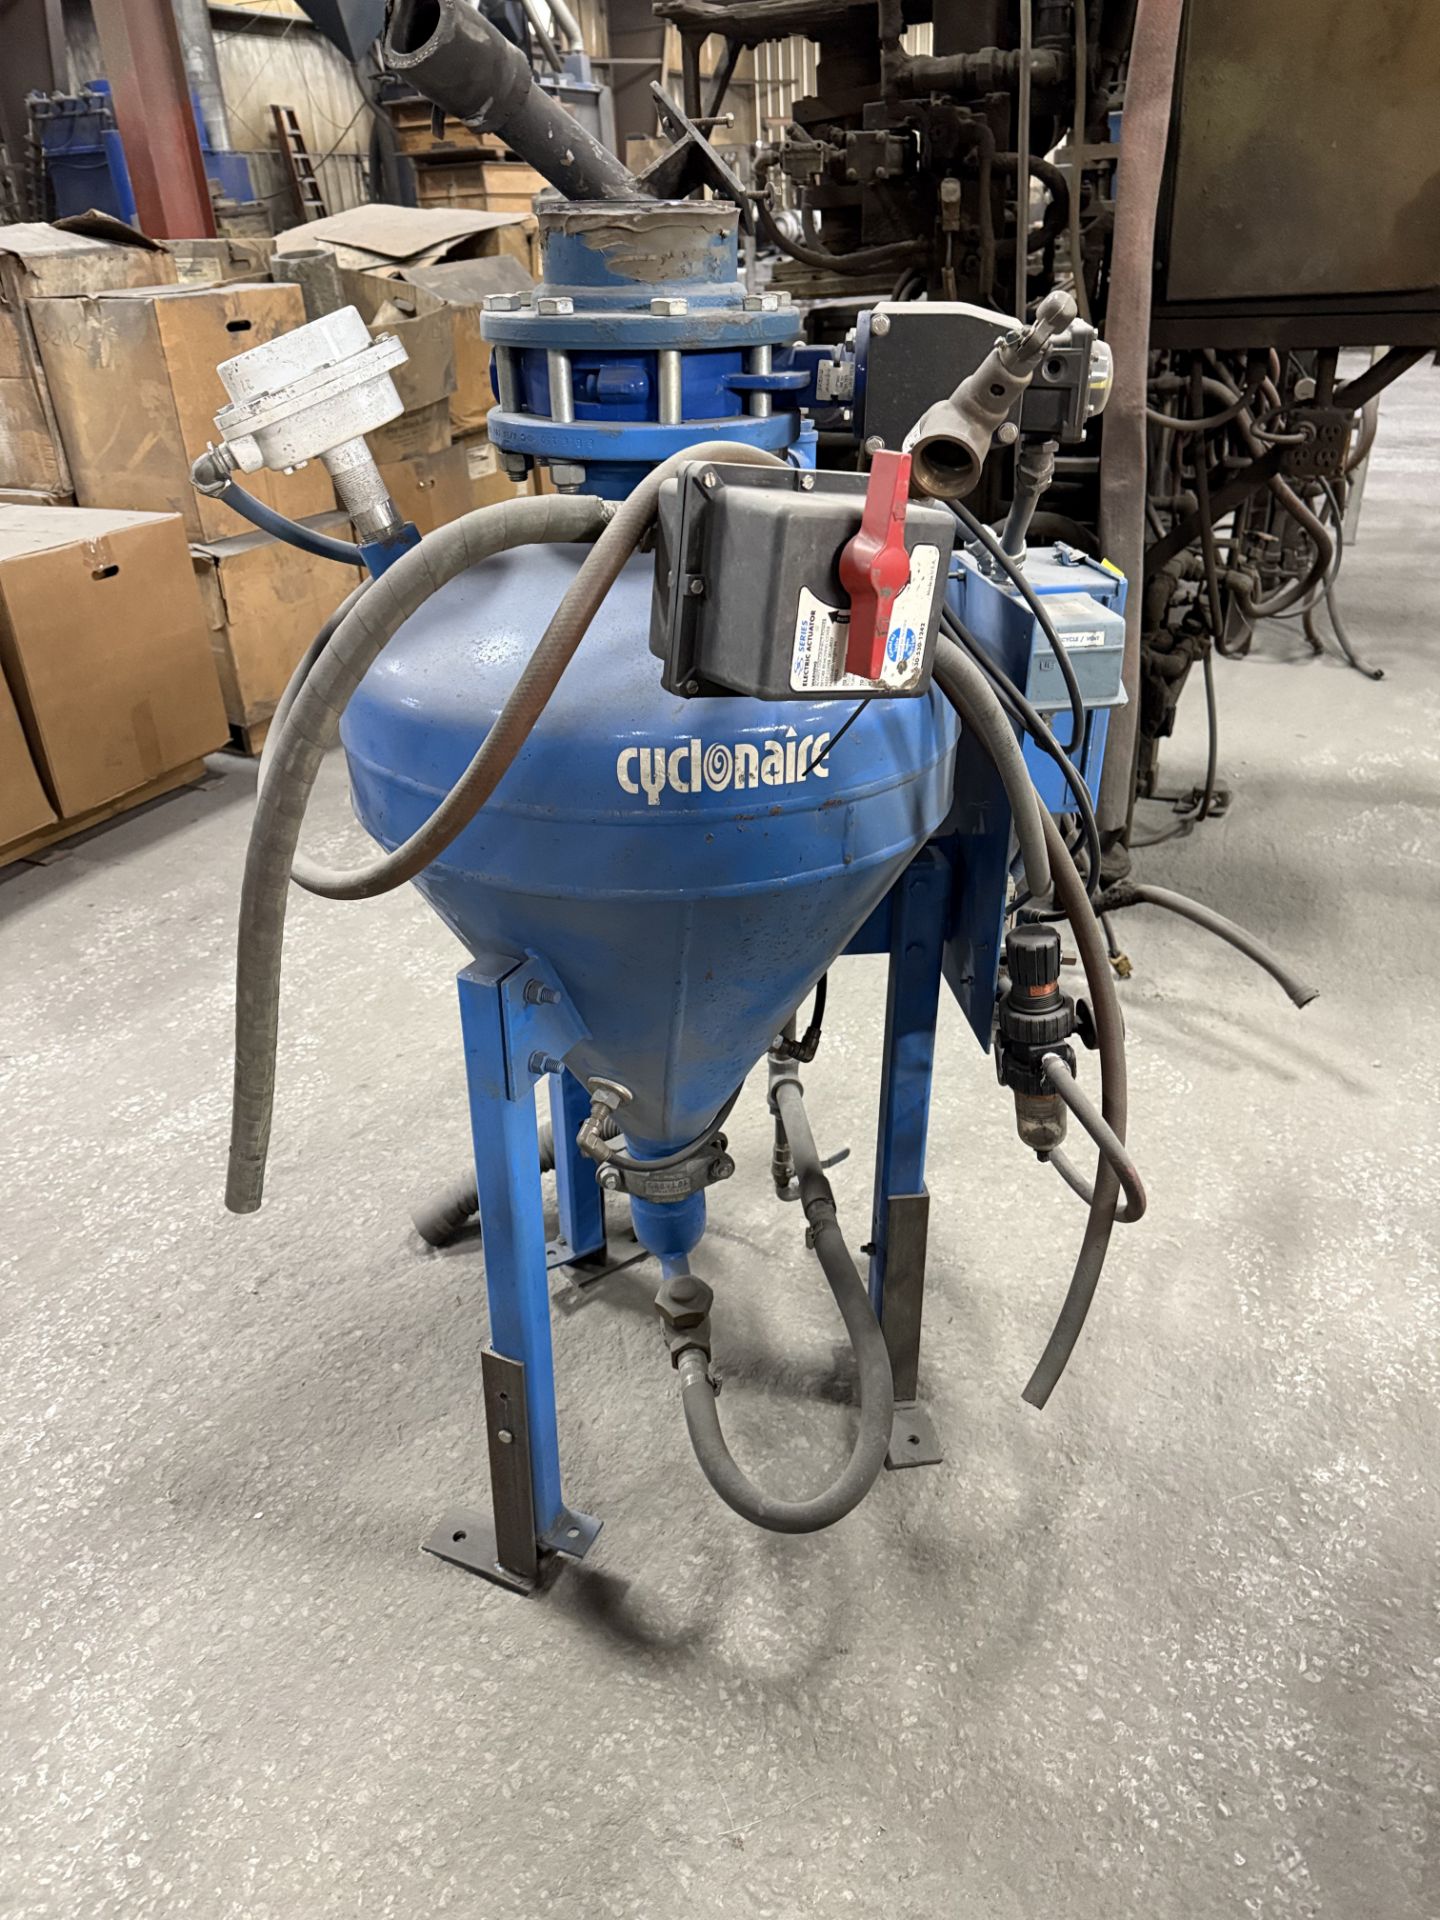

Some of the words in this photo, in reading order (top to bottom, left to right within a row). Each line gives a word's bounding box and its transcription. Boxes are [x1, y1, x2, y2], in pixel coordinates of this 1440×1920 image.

[798, 620, 808, 652] SERIES
[806, 610, 816, 652] ACTUATOR
[802, 654, 811, 687] ELECTRIC
[616, 726, 831, 806] cyclonaire
